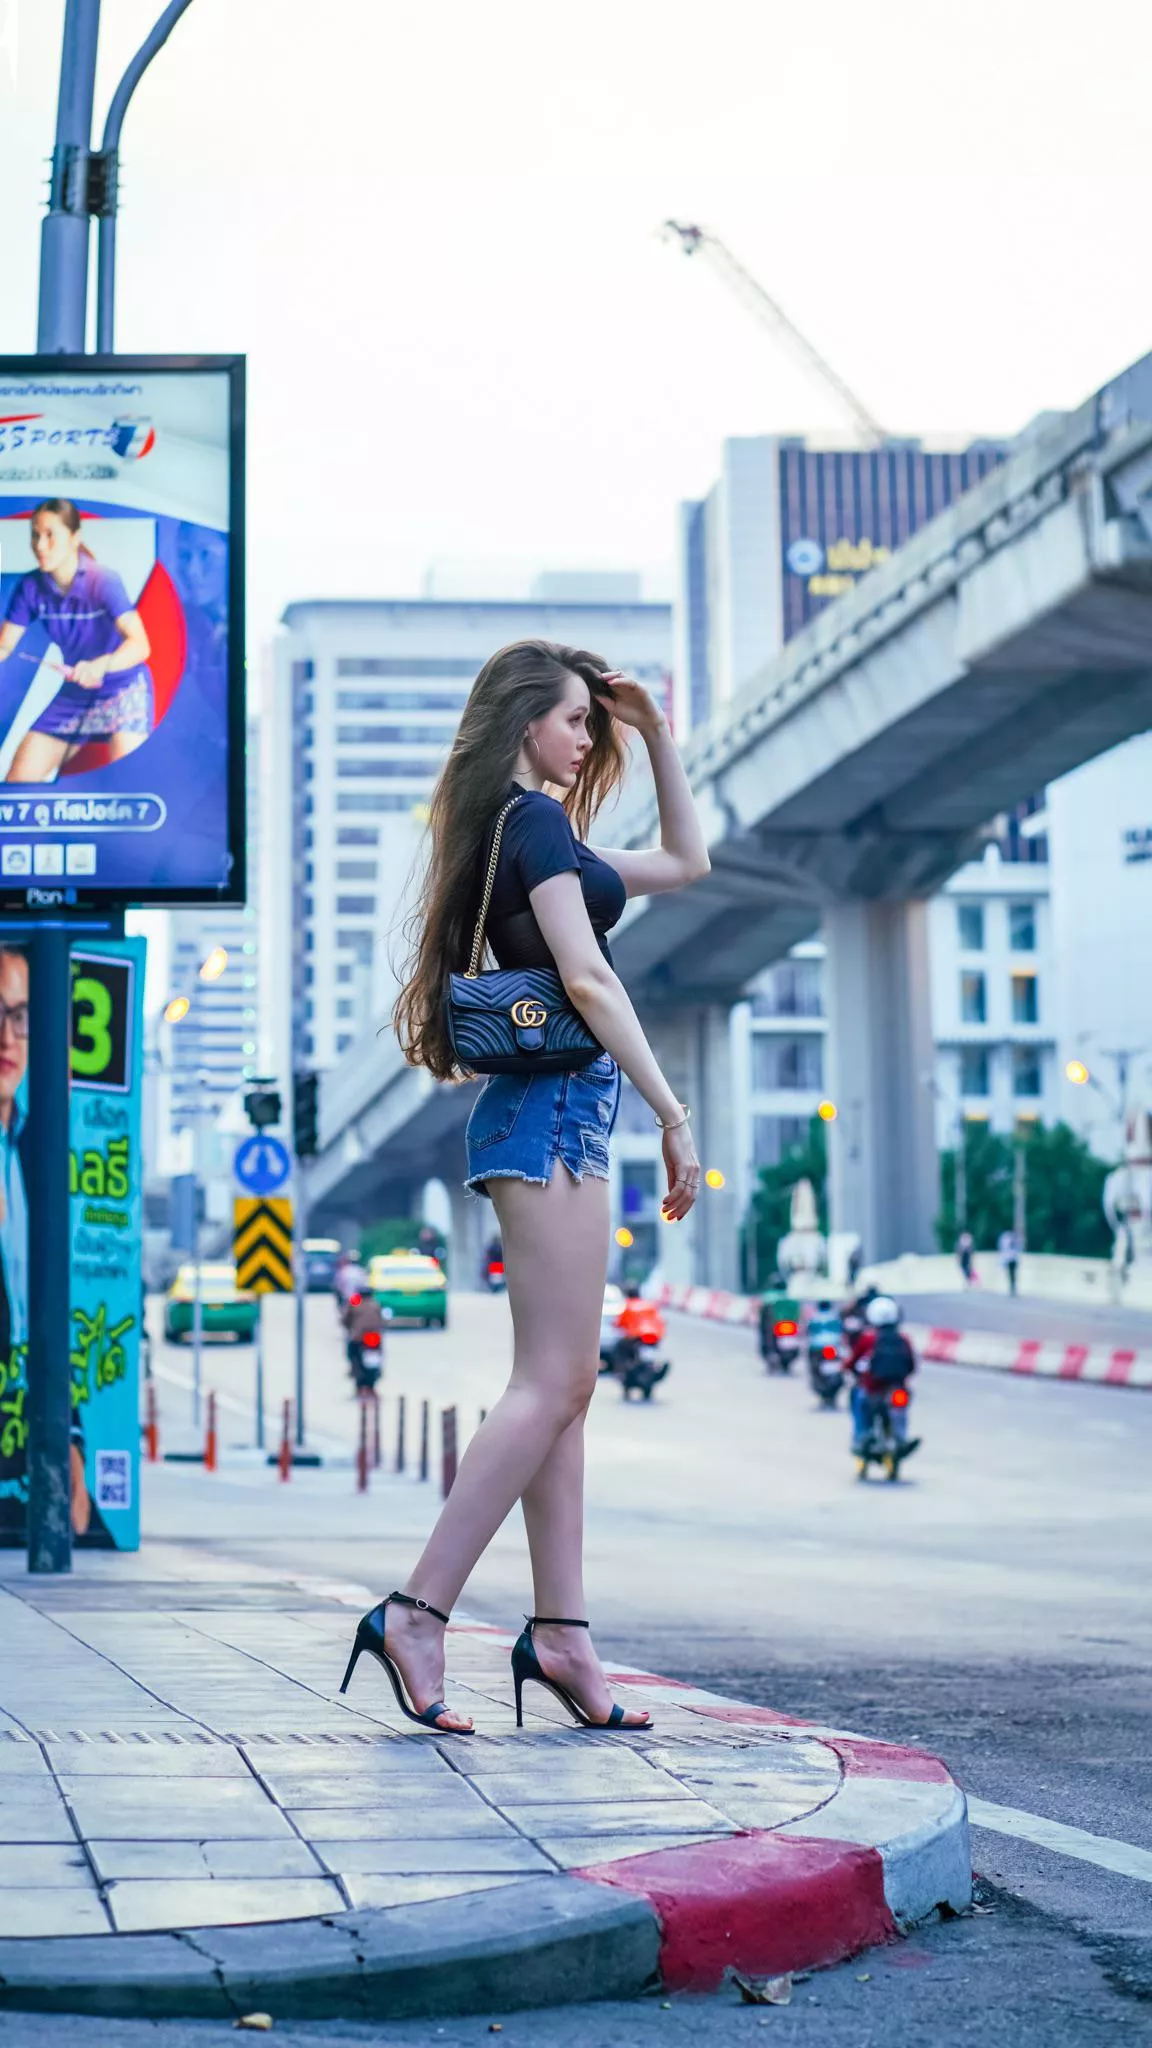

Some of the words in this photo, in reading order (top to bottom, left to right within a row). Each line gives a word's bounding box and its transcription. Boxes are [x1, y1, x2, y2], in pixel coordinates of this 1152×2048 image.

[18, 803, 31, 821] 7
[137, 802, 150, 821] 7
[69, 978, 111, 1075] 3
[511, 1001, 547, 1027] GG
